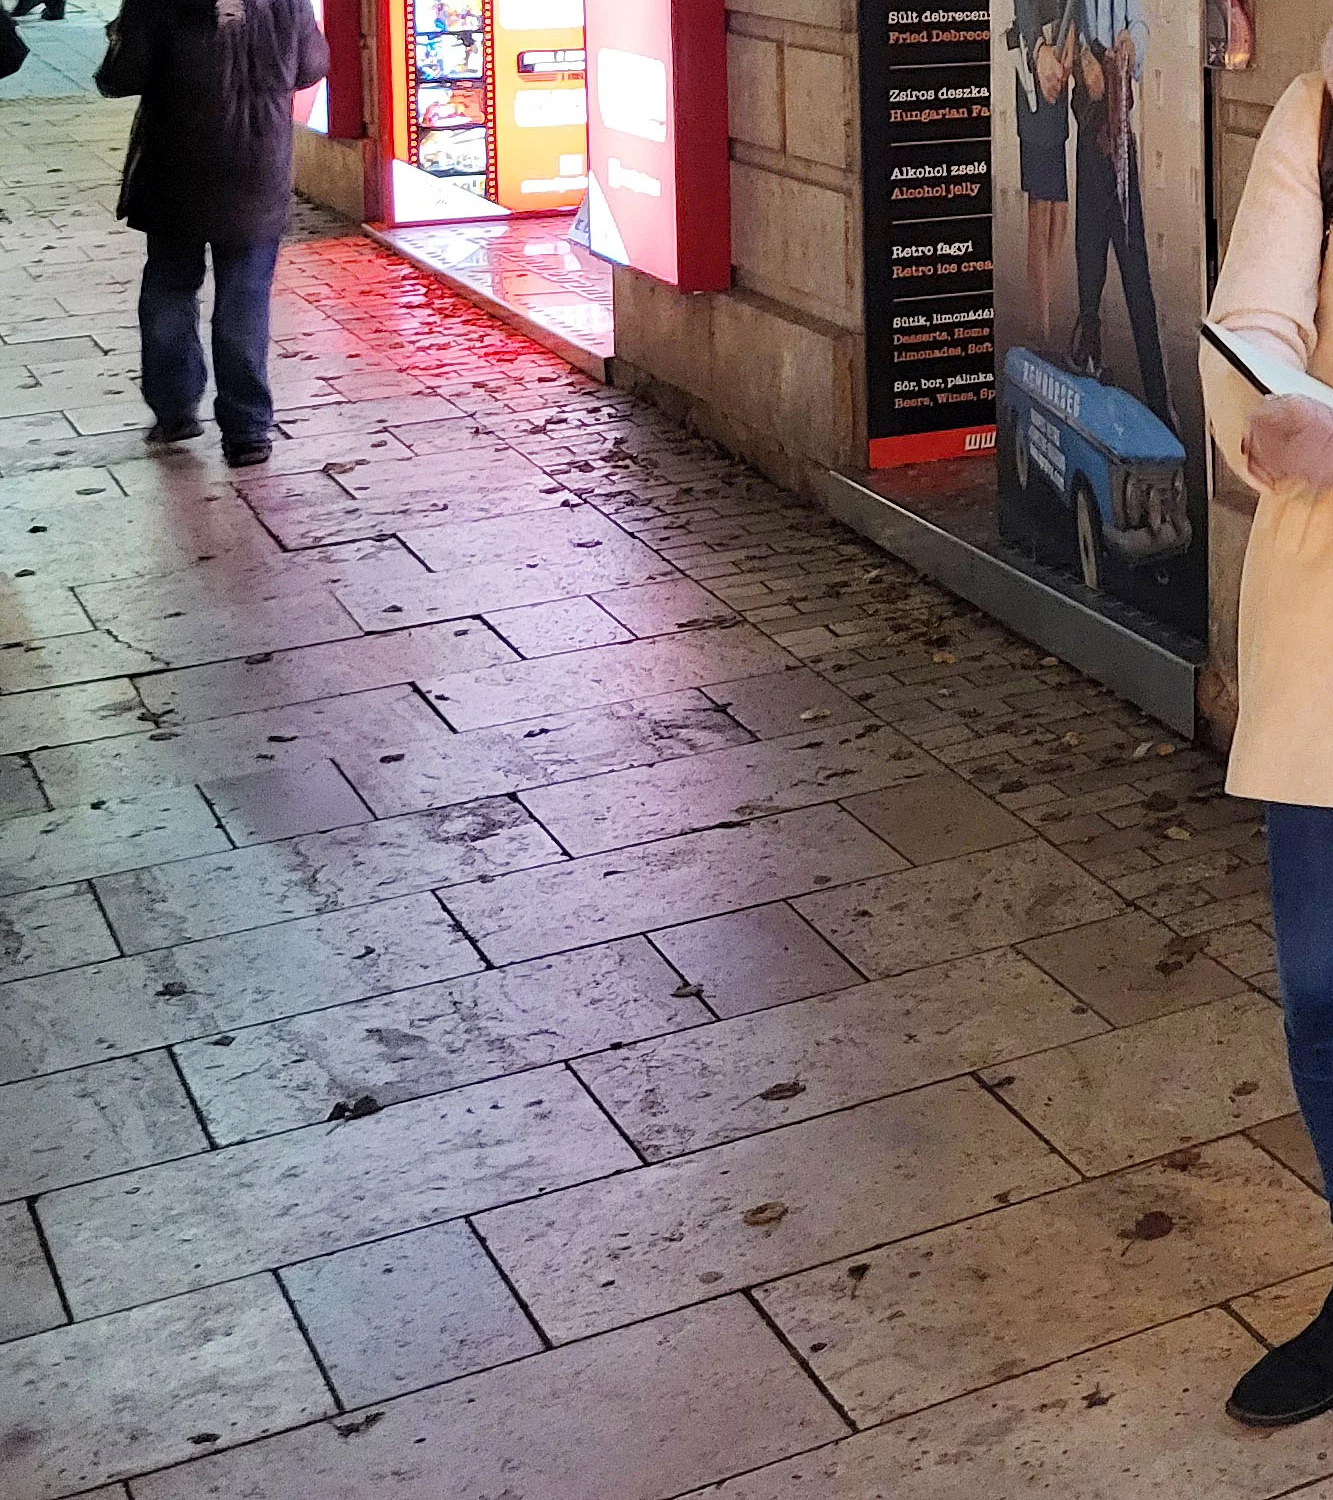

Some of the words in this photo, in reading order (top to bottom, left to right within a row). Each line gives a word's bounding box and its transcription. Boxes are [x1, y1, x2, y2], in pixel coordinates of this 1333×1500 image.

[888, 10, 919, 24] Sült
[922, 9, 990, 22] debrecen
[889, 30, 928, 44] Fried
[889, 88, 935, 102] Zsíros
[938, 85, 989, 100] deszka
[890, 107, 968, 123] Hungarian
[890, 163, 948, 180] Alkohol
[951, 161, 987, 175] zselé
[891, 184, 946, 200] Alcohol
[948, 182, 981, 198] jelly
[892, 245, 933, 259] Retro
[937, 241, 974, 258] fagyi
[892, 265, 934, 279] Retro
[937, 262, 957, 274] ice
[893, 315, 930, 329] Sütik,
[893, 331, 951, 345] Desserts,
[954, 327, 990, 339] Home
[894, 348, 966, 363] Limonades,
[968, 342, 994, 356] Soft
[894, 378, 918, 393] Sör,
[921, 376, 945, 390] bor,
[948, 372, 994, 388] pálinka
[894, 395, 934, 409] Beers,
[936, 392, 977, 406] Wines,
